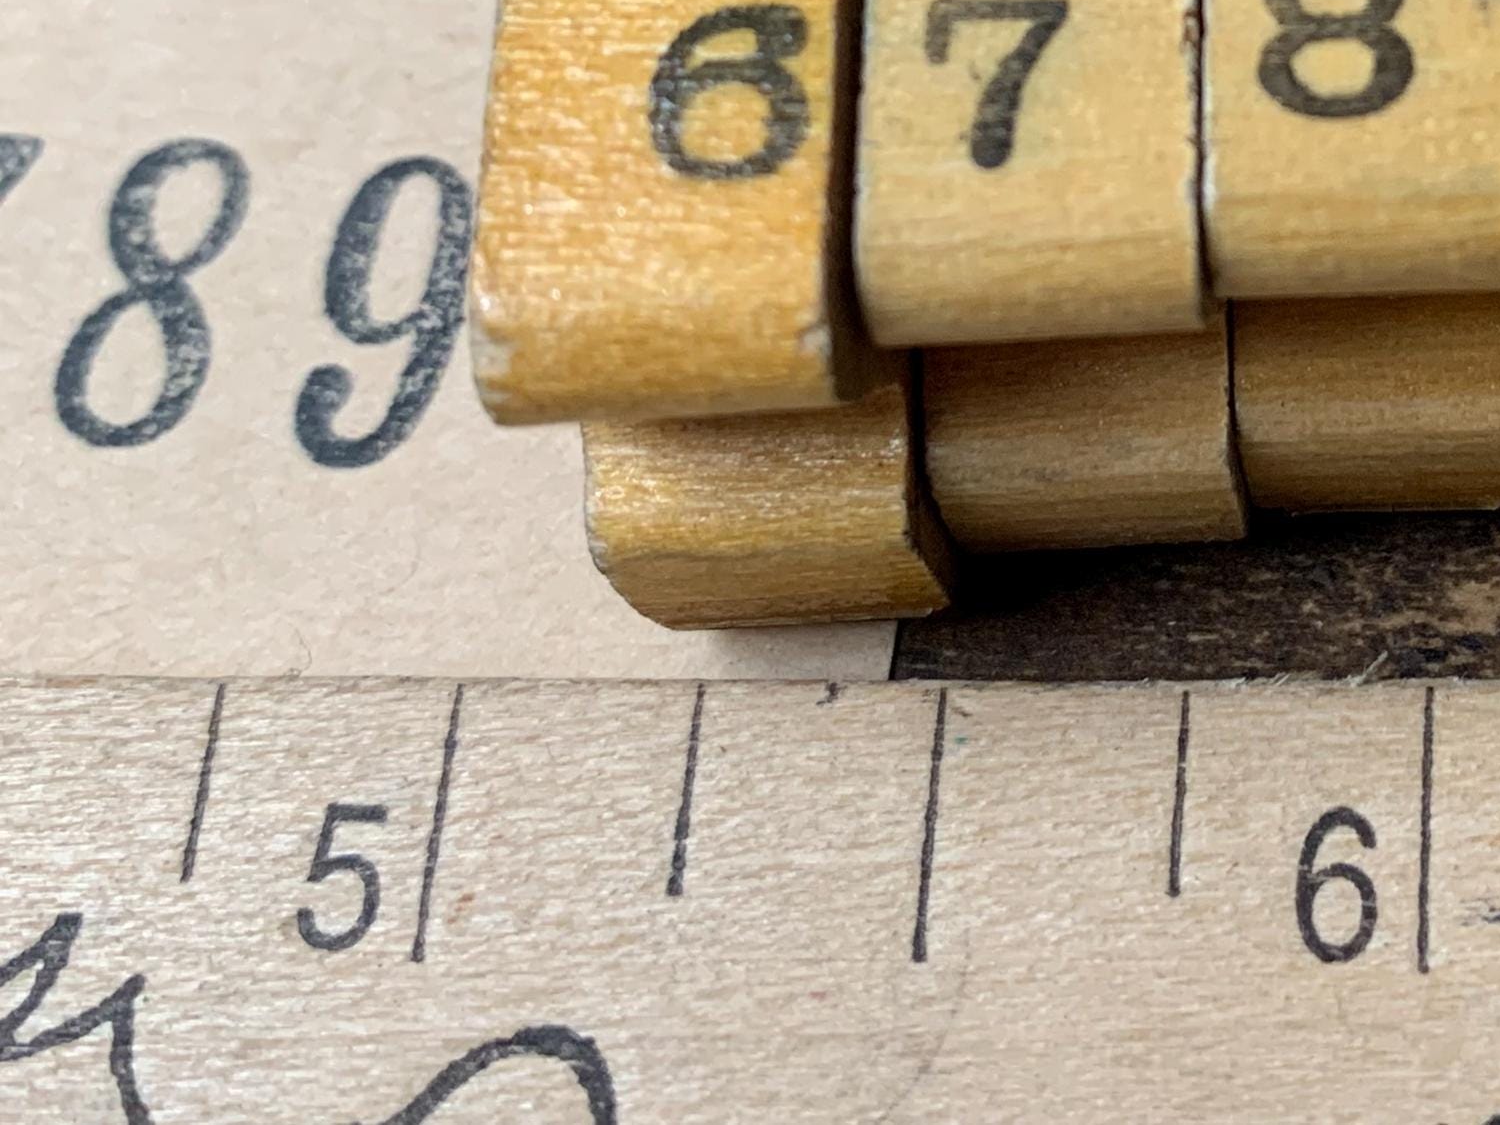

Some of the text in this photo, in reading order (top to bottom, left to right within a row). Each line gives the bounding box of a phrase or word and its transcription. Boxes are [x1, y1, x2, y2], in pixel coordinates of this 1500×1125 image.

[647, 1, 812, 182] 6
[297, 802, 390, 953] 5
[1294, 805, 1379, 965] 6
